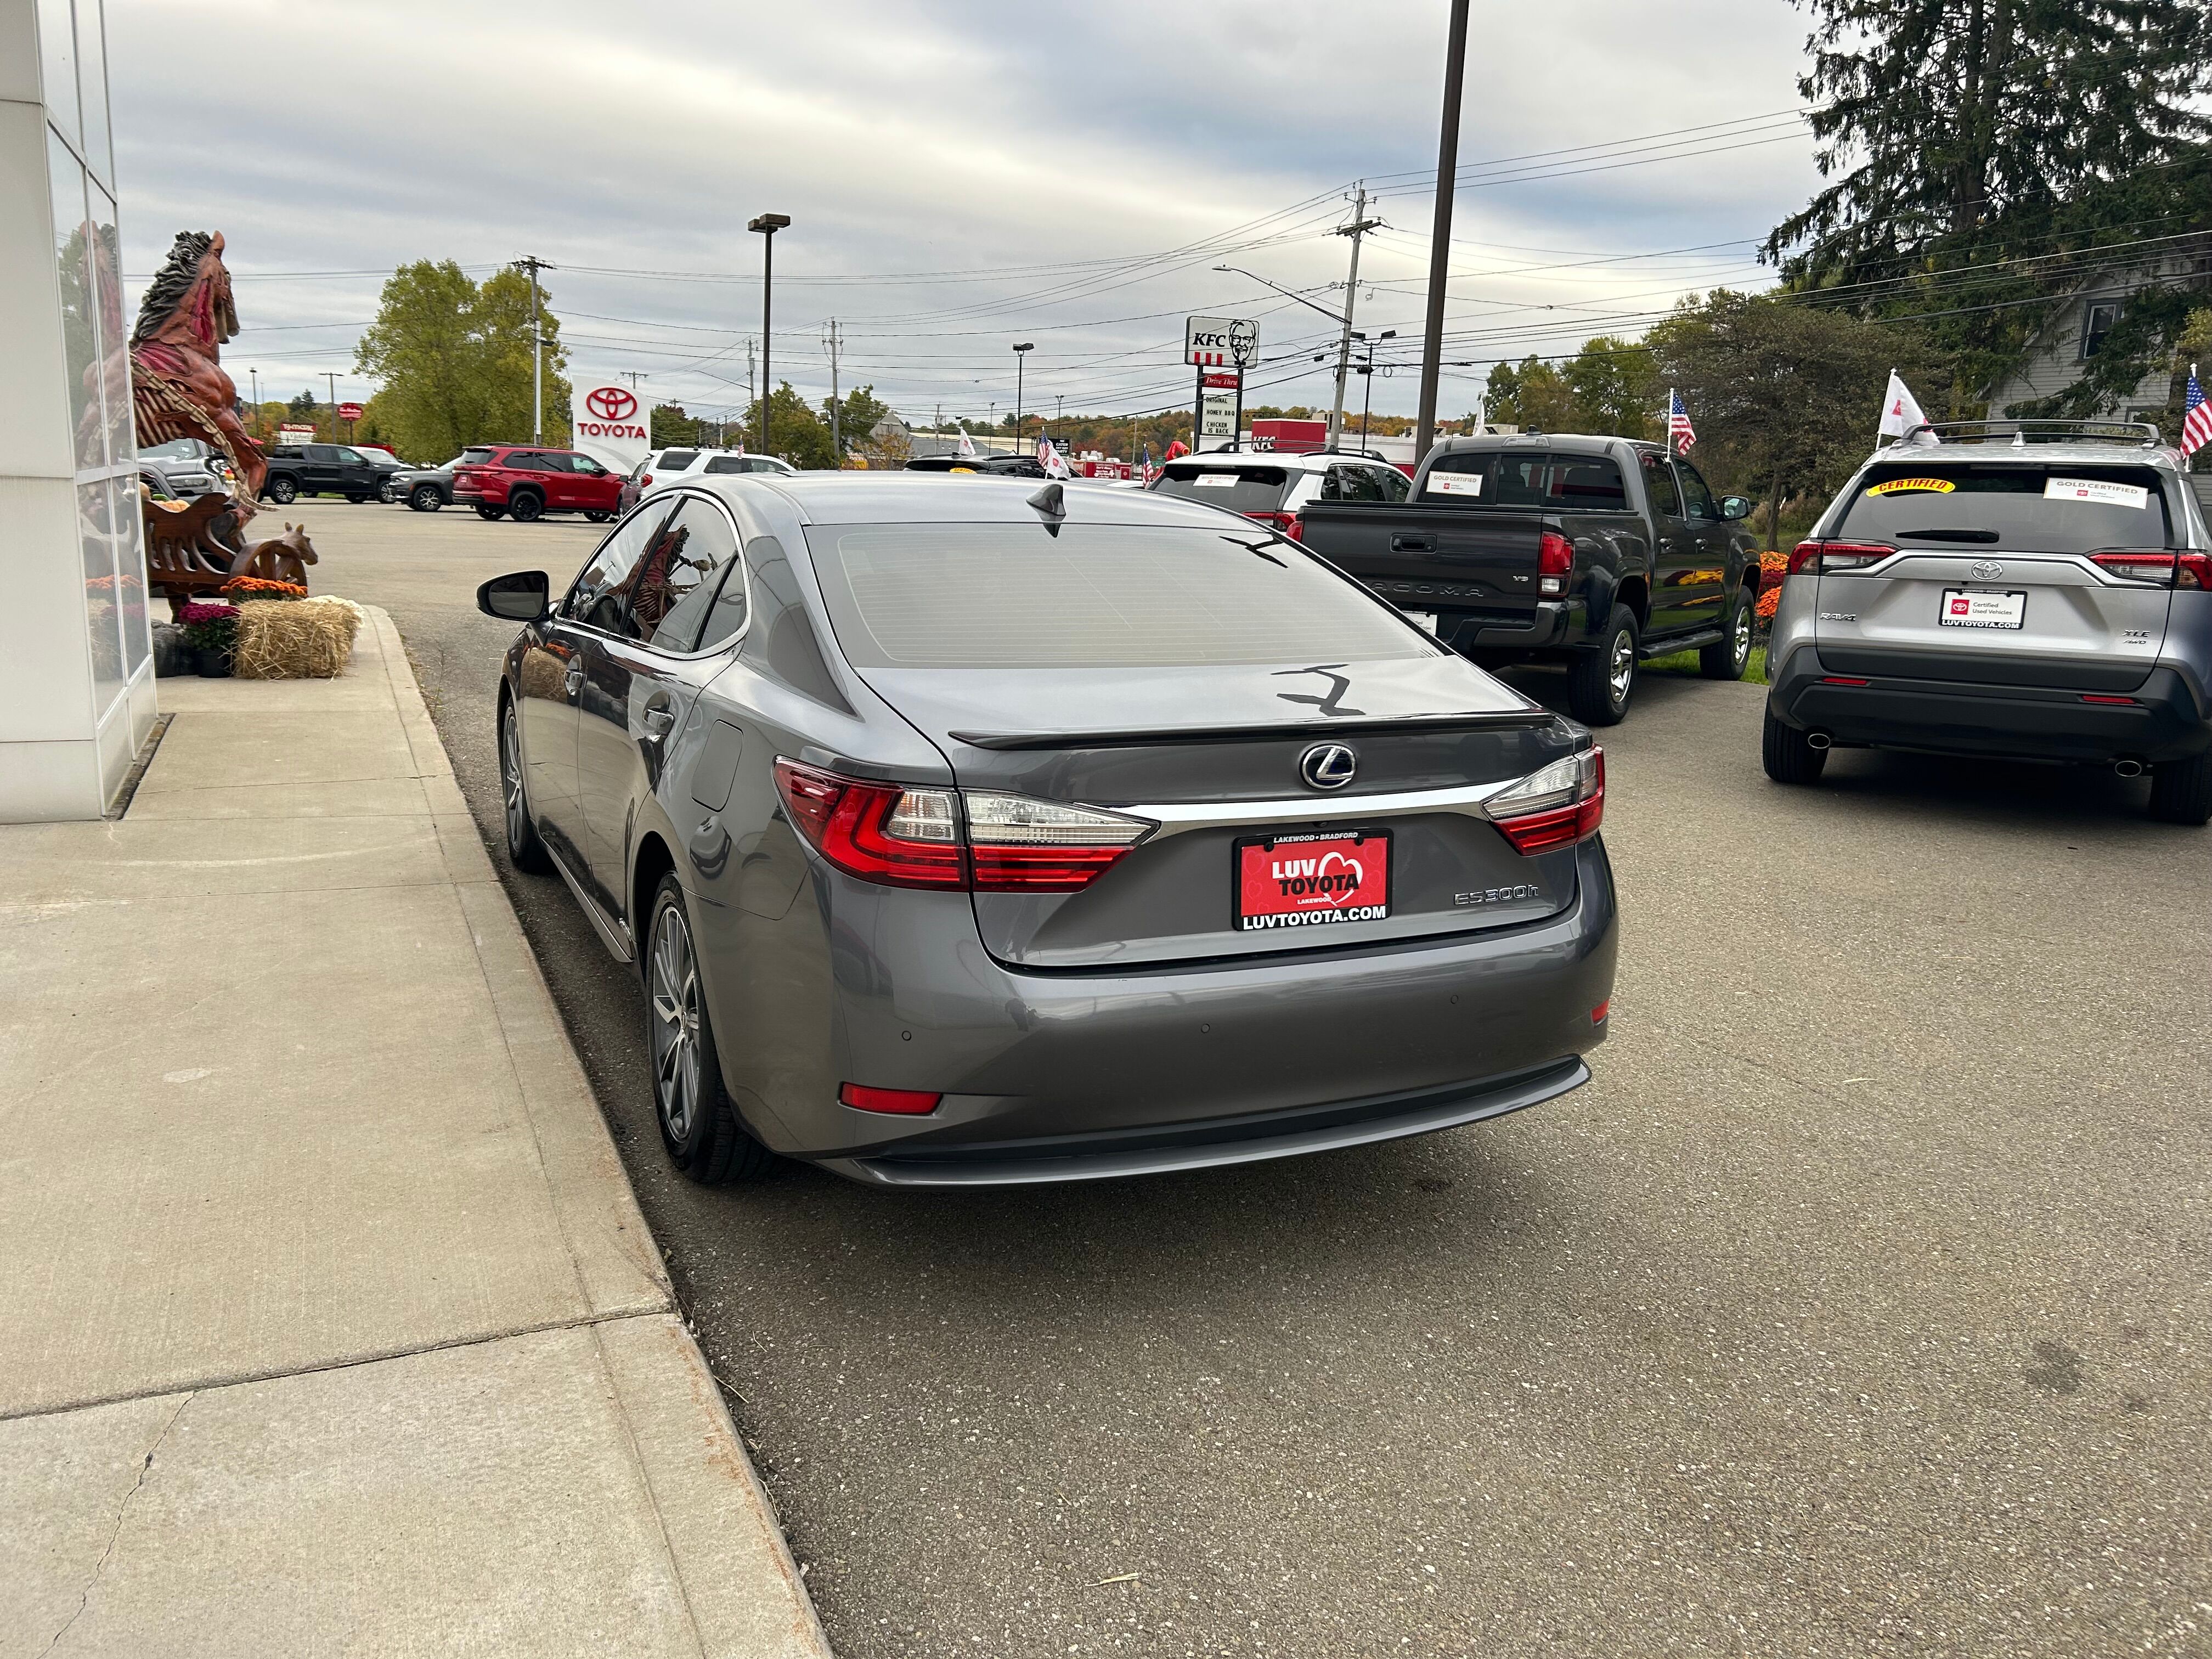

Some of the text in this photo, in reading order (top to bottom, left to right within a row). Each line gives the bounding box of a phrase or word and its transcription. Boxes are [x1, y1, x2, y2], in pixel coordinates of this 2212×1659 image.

[1193, 332, 1226, 347] KFC
[1206, 376, 1238, 386] Drive Thru
[577, 422, 646, 439] TOYOTA
[1251, 436, 1276, 450] KFC
[1878, 479, 1948, 492] CERTIFIED
[2087, 483, 2138, 494] CERTIFIED
[1820, 612, 1857, 620] RAV4
[1942, 619, 2019, 629] LUVTOYOTA.COM
[1273, 832, 1358, 843] LAKEWOOD BRADFORD
[1272, 858, 1317, 879] LUV
[1278, 873, 1359, 896] TOYOTA
[1297, 896, 1333, 905] LAKEWOOD
[1243, 905, 1386, 930] LUVTOYOTA.COM
